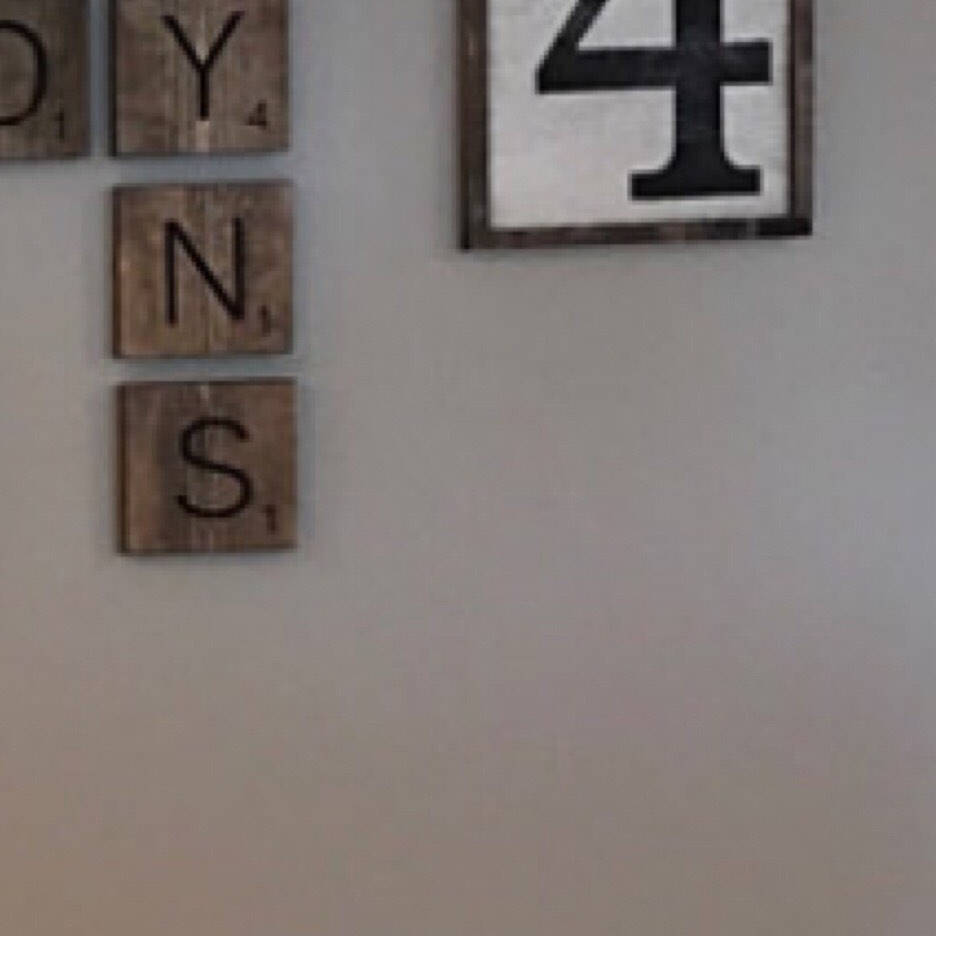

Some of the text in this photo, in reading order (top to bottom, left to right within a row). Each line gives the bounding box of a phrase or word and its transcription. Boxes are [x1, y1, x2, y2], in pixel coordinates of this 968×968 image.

[246, 101, 268, 130] 4
[259, 304, 272, 336] 1
[264, 503, 279, 535] 1
